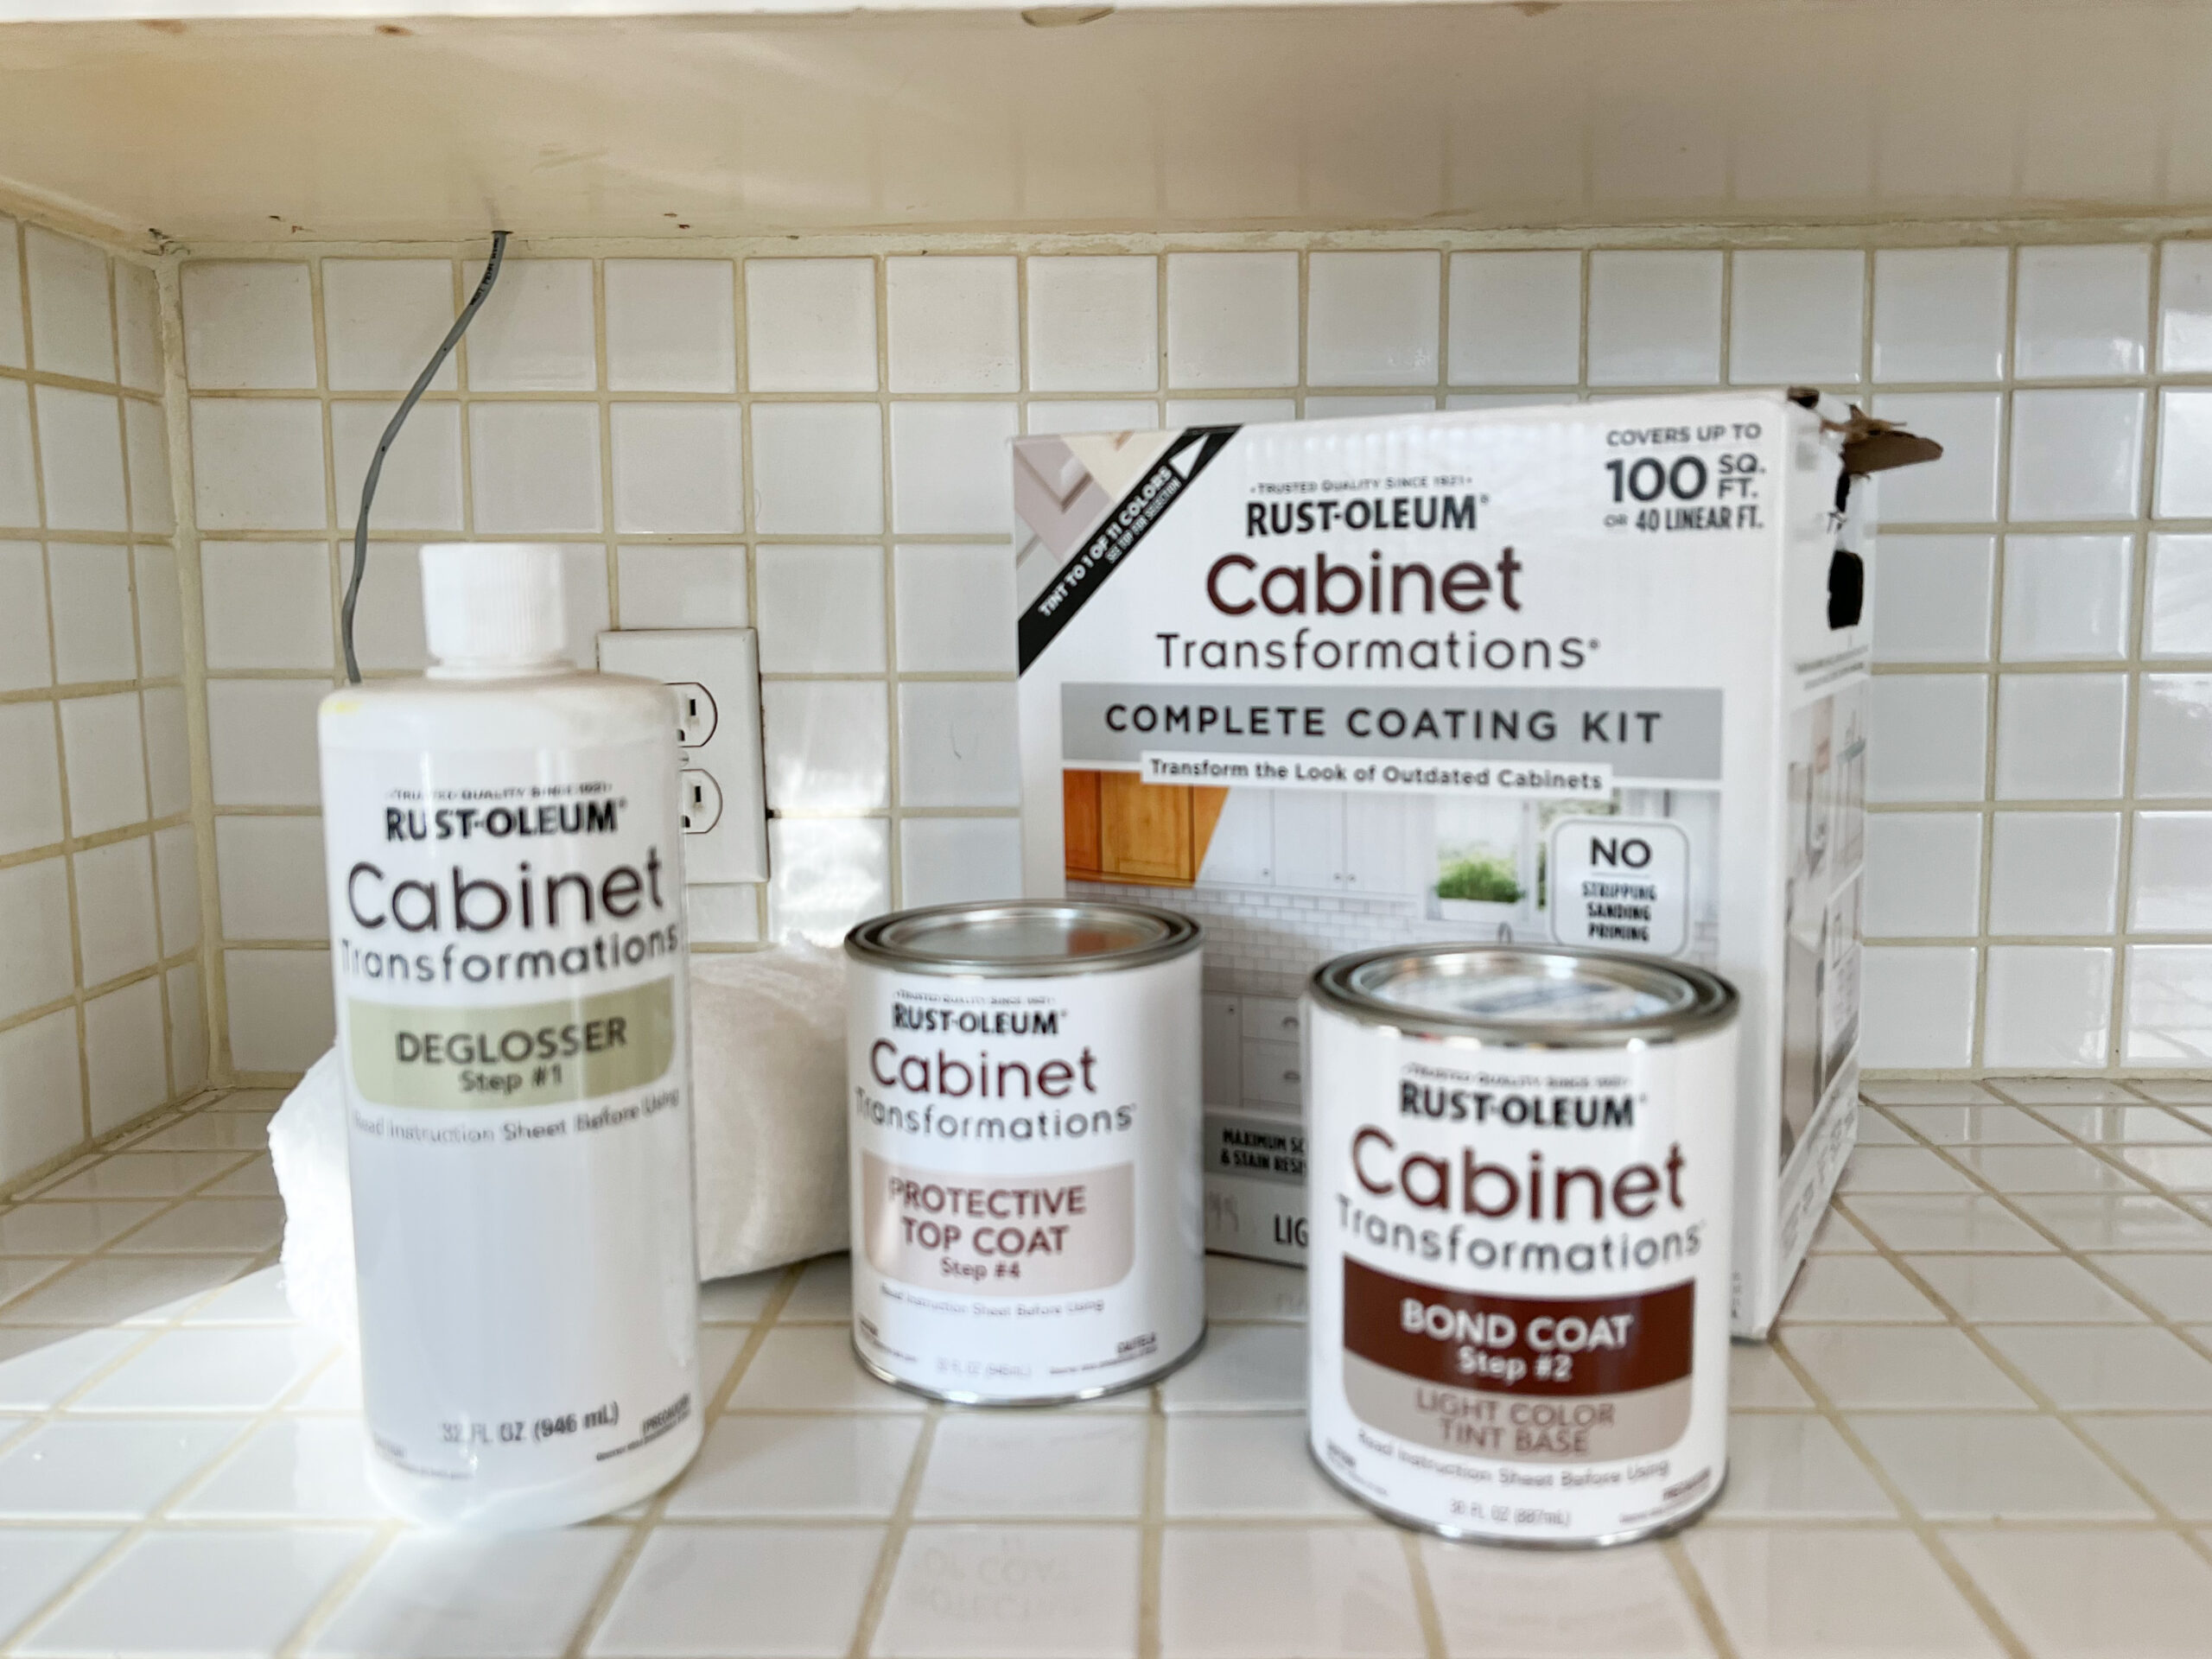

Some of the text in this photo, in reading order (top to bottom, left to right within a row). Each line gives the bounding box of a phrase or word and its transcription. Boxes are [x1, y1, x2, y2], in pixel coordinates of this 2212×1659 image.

[1606, 423, 1762, 447] COVERS UP TO
[1257, 481, 1317, 494] TRUSTED
[1321, 480, 1378, 492] QUALITY
[1385, 476, 1426, 490] SINCE
[1605, 454, 1766, 503] 100 SQ. FT.
[1637, 509, 1658, 532] 40
[1665, 506, 1730, 531] LINEAR
[1737, 505, 1763, 528] FT.
[1038, 582, 1069, 616] TINT
[1064, 563, 1086, 587] TO
[1082, 555, 1094, 568] 1
[1090, 534, 1109, 560] OF
[1119, 465, 1173, 526] COLORS
[1206, 547, 1522, 616] Cabinet
[1156, 628, 1586, 671] Transformations
[1107, 704, 1662, 743] COMPLETE COATING KIT
[1151, 759, 1602, 790] Transform the Look of Outdated Cabinets
[1591, 836, 1652, 868] NO
[347, 845, 664, 932] Cabinet
[1587, 902, 1650, 921] SANDING
[340, 922, 678, 983] Transformations
[395, 1016, 627, 1065] DEGLOSSER
[458, 1062, 562, 1095] Step #1
[870, 1038, 1097, 1098] Cabinet
[503, 1121, 566, 1142] Sheet
[575, 1105, 640, 1134] Before
[640, 1090, 680, 1116] Using
[855, 1087, 1133, 1141] Transformations
[1221, 1147, 1230, 1165] &
[1234, 1150, 1269, 1168] STAIN
[1223, 1128, 1287, 1152] MAXIMUM
[1352, 1125, 1685, 1222] Cabinet
[887, 1175, 1087, 1221] PROTECTIVE
[900, 1215, 1071, 1257] TOP COAT
[1338, 1194, 1701, 1273] Transformations
[940, 1257, 1020, 1281] Step #4
[973, 1301, 1012, 1316] Sheet
[1017, 1302, 1062, 1316] Before
[1402, 1297, 1633, 1353] BOND COAT
[1457, 1348, 1573, 1385] Step #2
[442, 1421, 463, 1443] 32
[470, 1421, 492, 1444] FL
[500, 1421, 524, 1442] OZ
[533, 1413, 577, 1444] (946
[584, 1401, 620, 1430] mL)
[1416, 1386, 1616, 1428] LIGHT COLOR
[1357, 1428, 1393, 1457] Read
[1498, 1465, 1554, 1487] Sheet
[1560, 1467, 1620, 1487] Before
[1626, 1459, 1670, 1482] Using
[1439, 1419, 1589, 1455] TINT BASE
